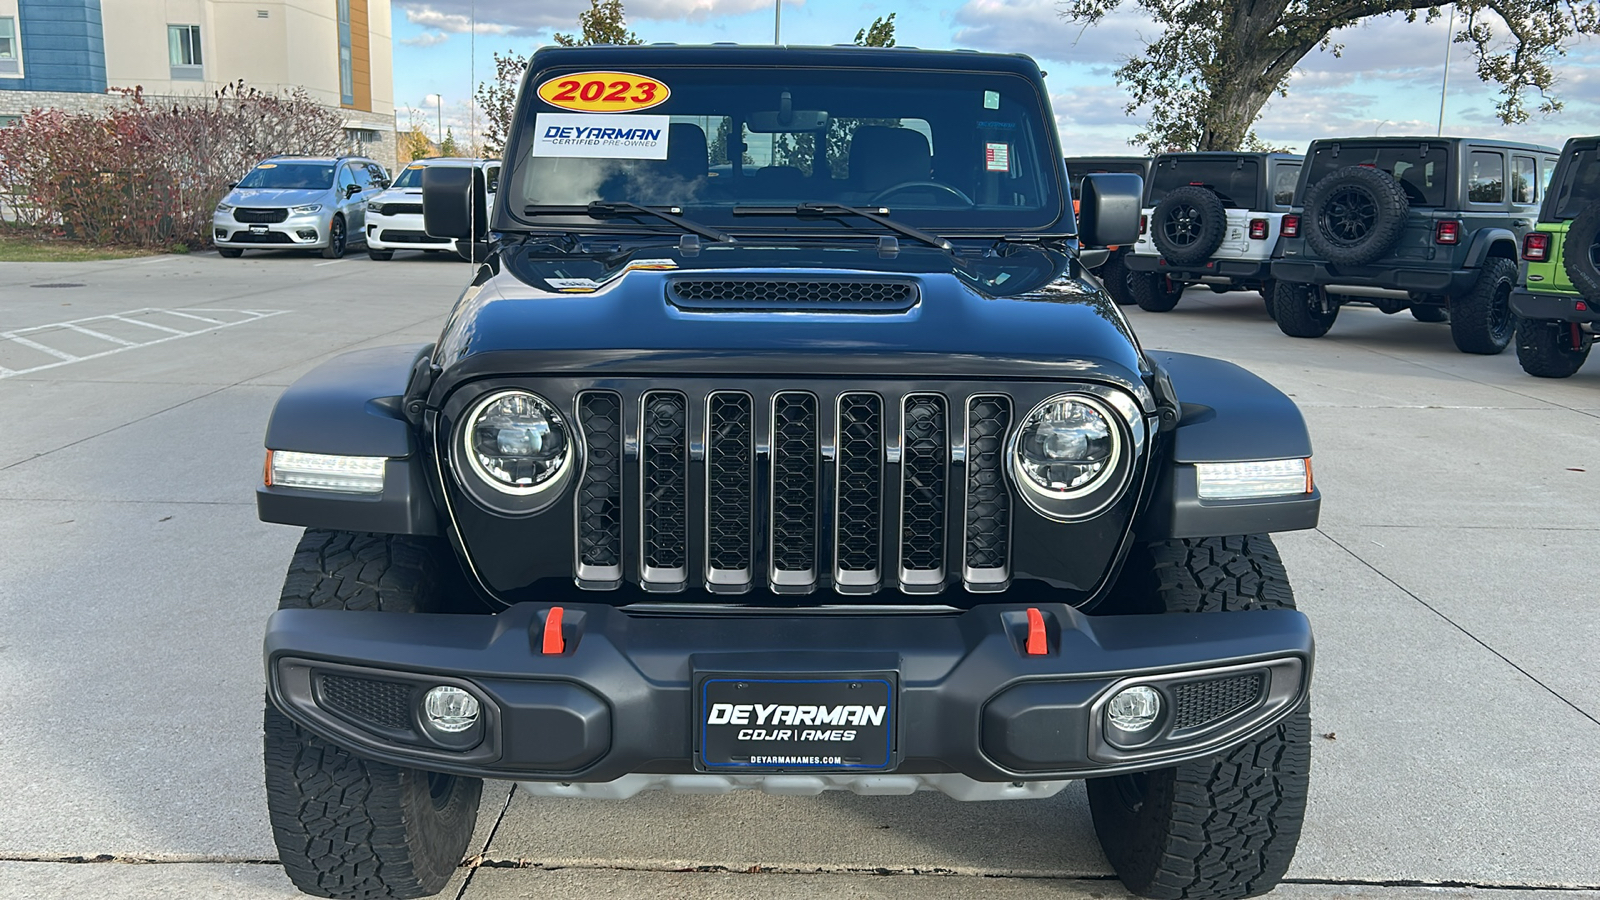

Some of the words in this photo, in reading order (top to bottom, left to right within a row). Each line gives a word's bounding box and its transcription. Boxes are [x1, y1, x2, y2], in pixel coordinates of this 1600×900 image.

[551, 80, 659, 104] 2023
[543, 126, 661, 141] DEYARMAN
[552, 138, 600, 146] CERTIFIED
[602, 139, 657, 147] PRE-OWNED
[707, 703, 887, 726] DEYARMAN
[737, 729, 792, 741] CDJR
[800, 729, 857, 741] AMES
[750, 755, 842, 764] DEYARMANAMES.COM
